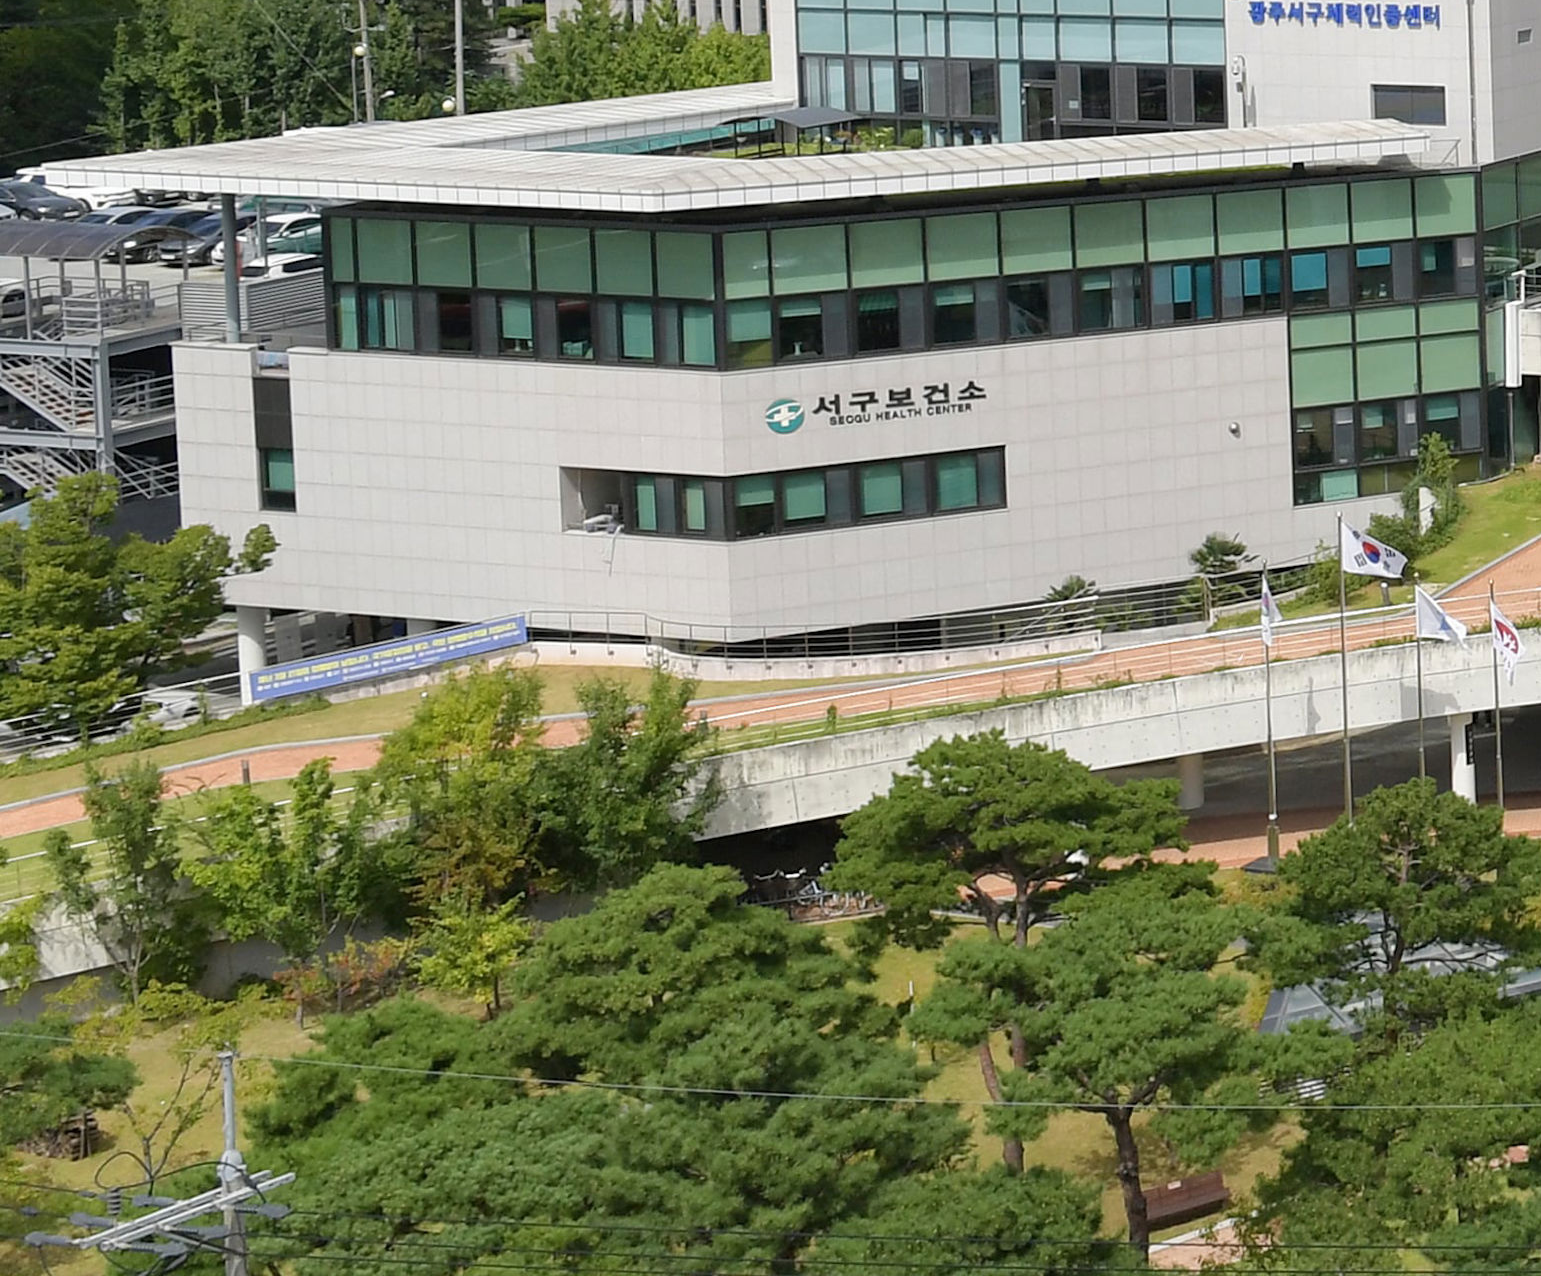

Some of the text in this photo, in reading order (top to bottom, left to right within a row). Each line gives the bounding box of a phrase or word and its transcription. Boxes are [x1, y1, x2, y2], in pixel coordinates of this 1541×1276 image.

[1248, 1, 1441, 30] 광주서구체력인증센터
[812, 380, 988, 416] 서구보건소
[829, 402, 973, 426] SEOGU HEALTH CENTER
